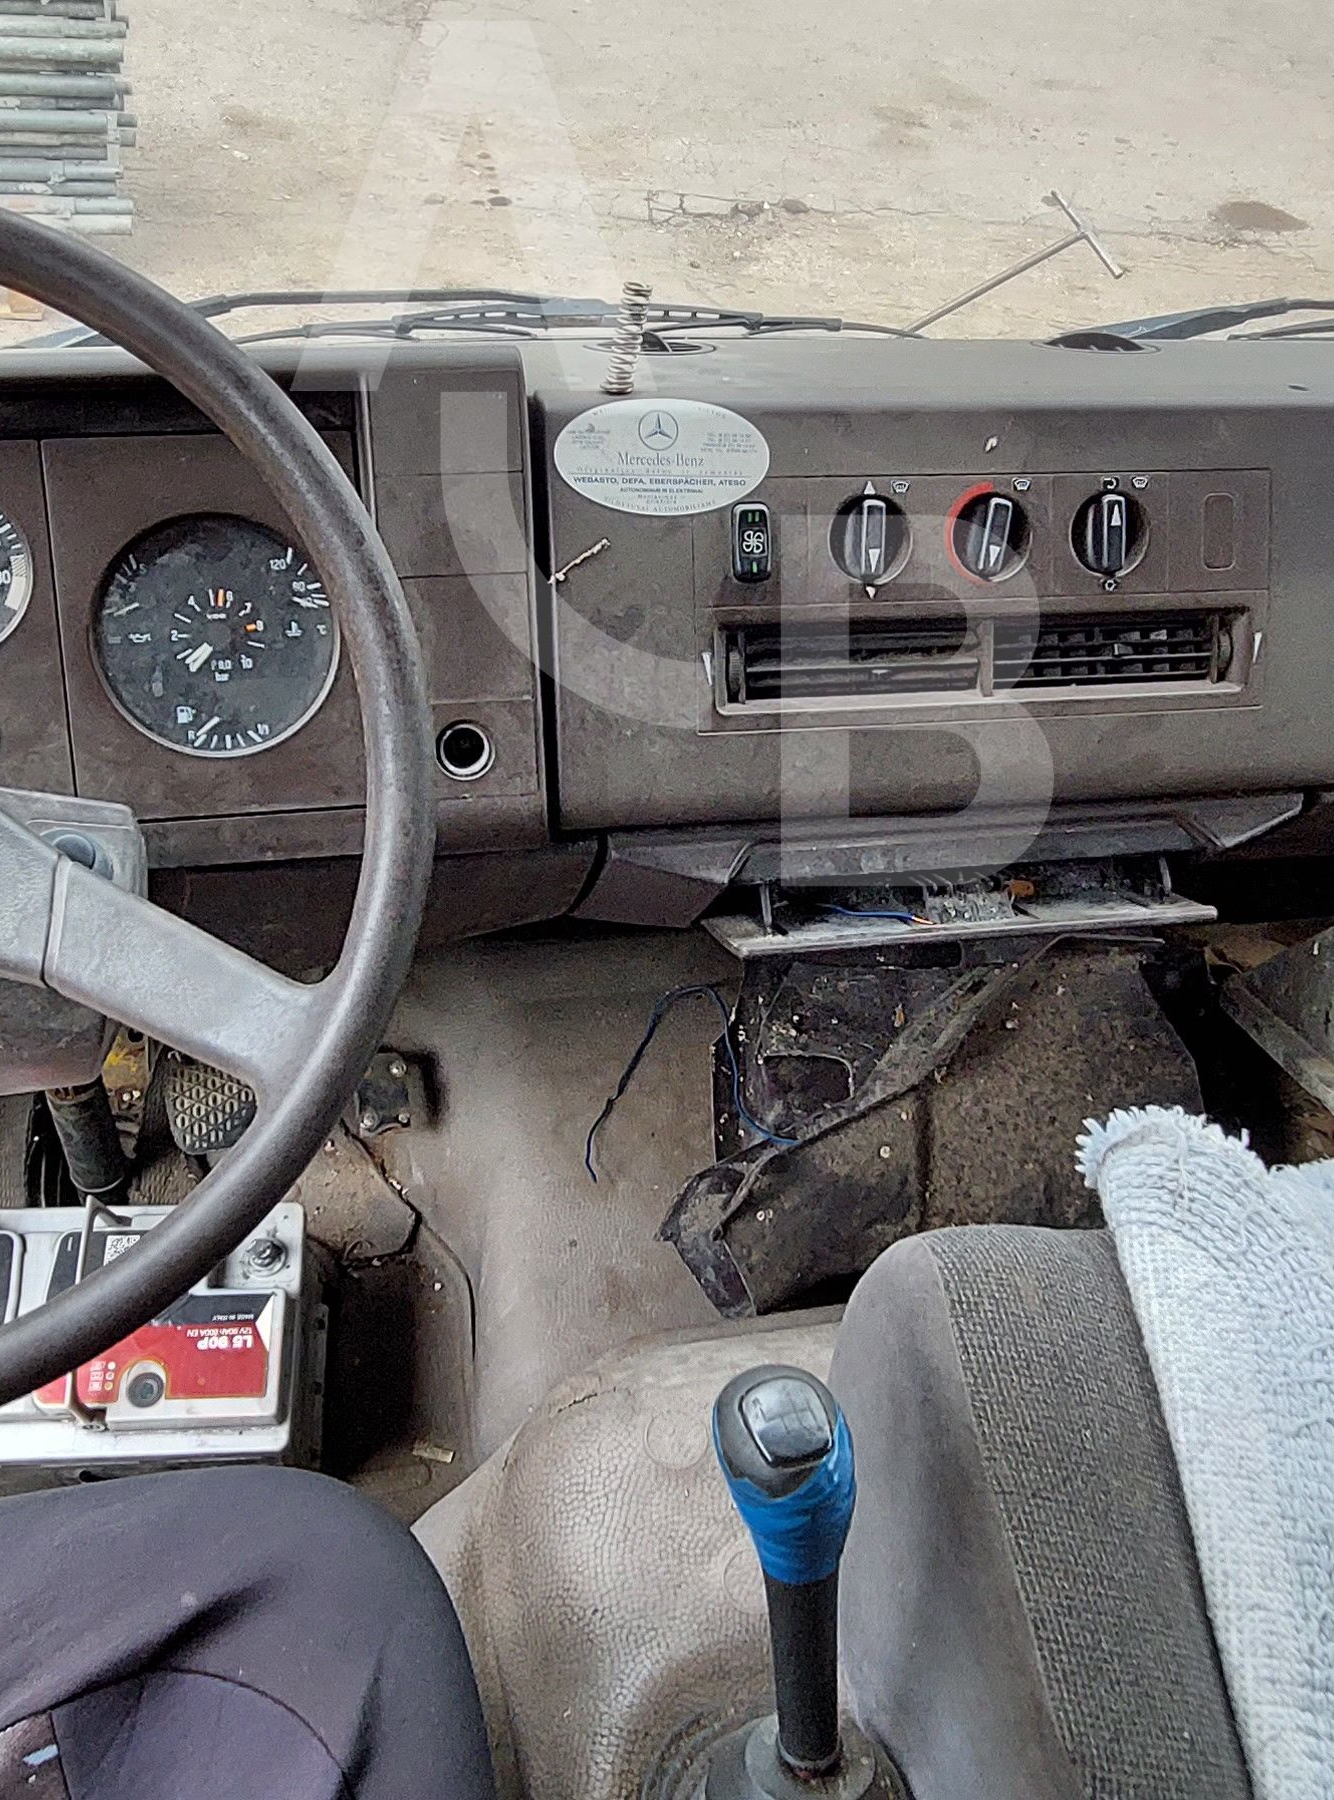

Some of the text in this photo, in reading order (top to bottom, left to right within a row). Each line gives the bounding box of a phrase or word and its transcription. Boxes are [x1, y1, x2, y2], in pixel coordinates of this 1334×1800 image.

[617, 451, 705, 467] Mercedes-Benz
[269, 558, 287, 571] 120
[170, 629, 179, 641] 2
